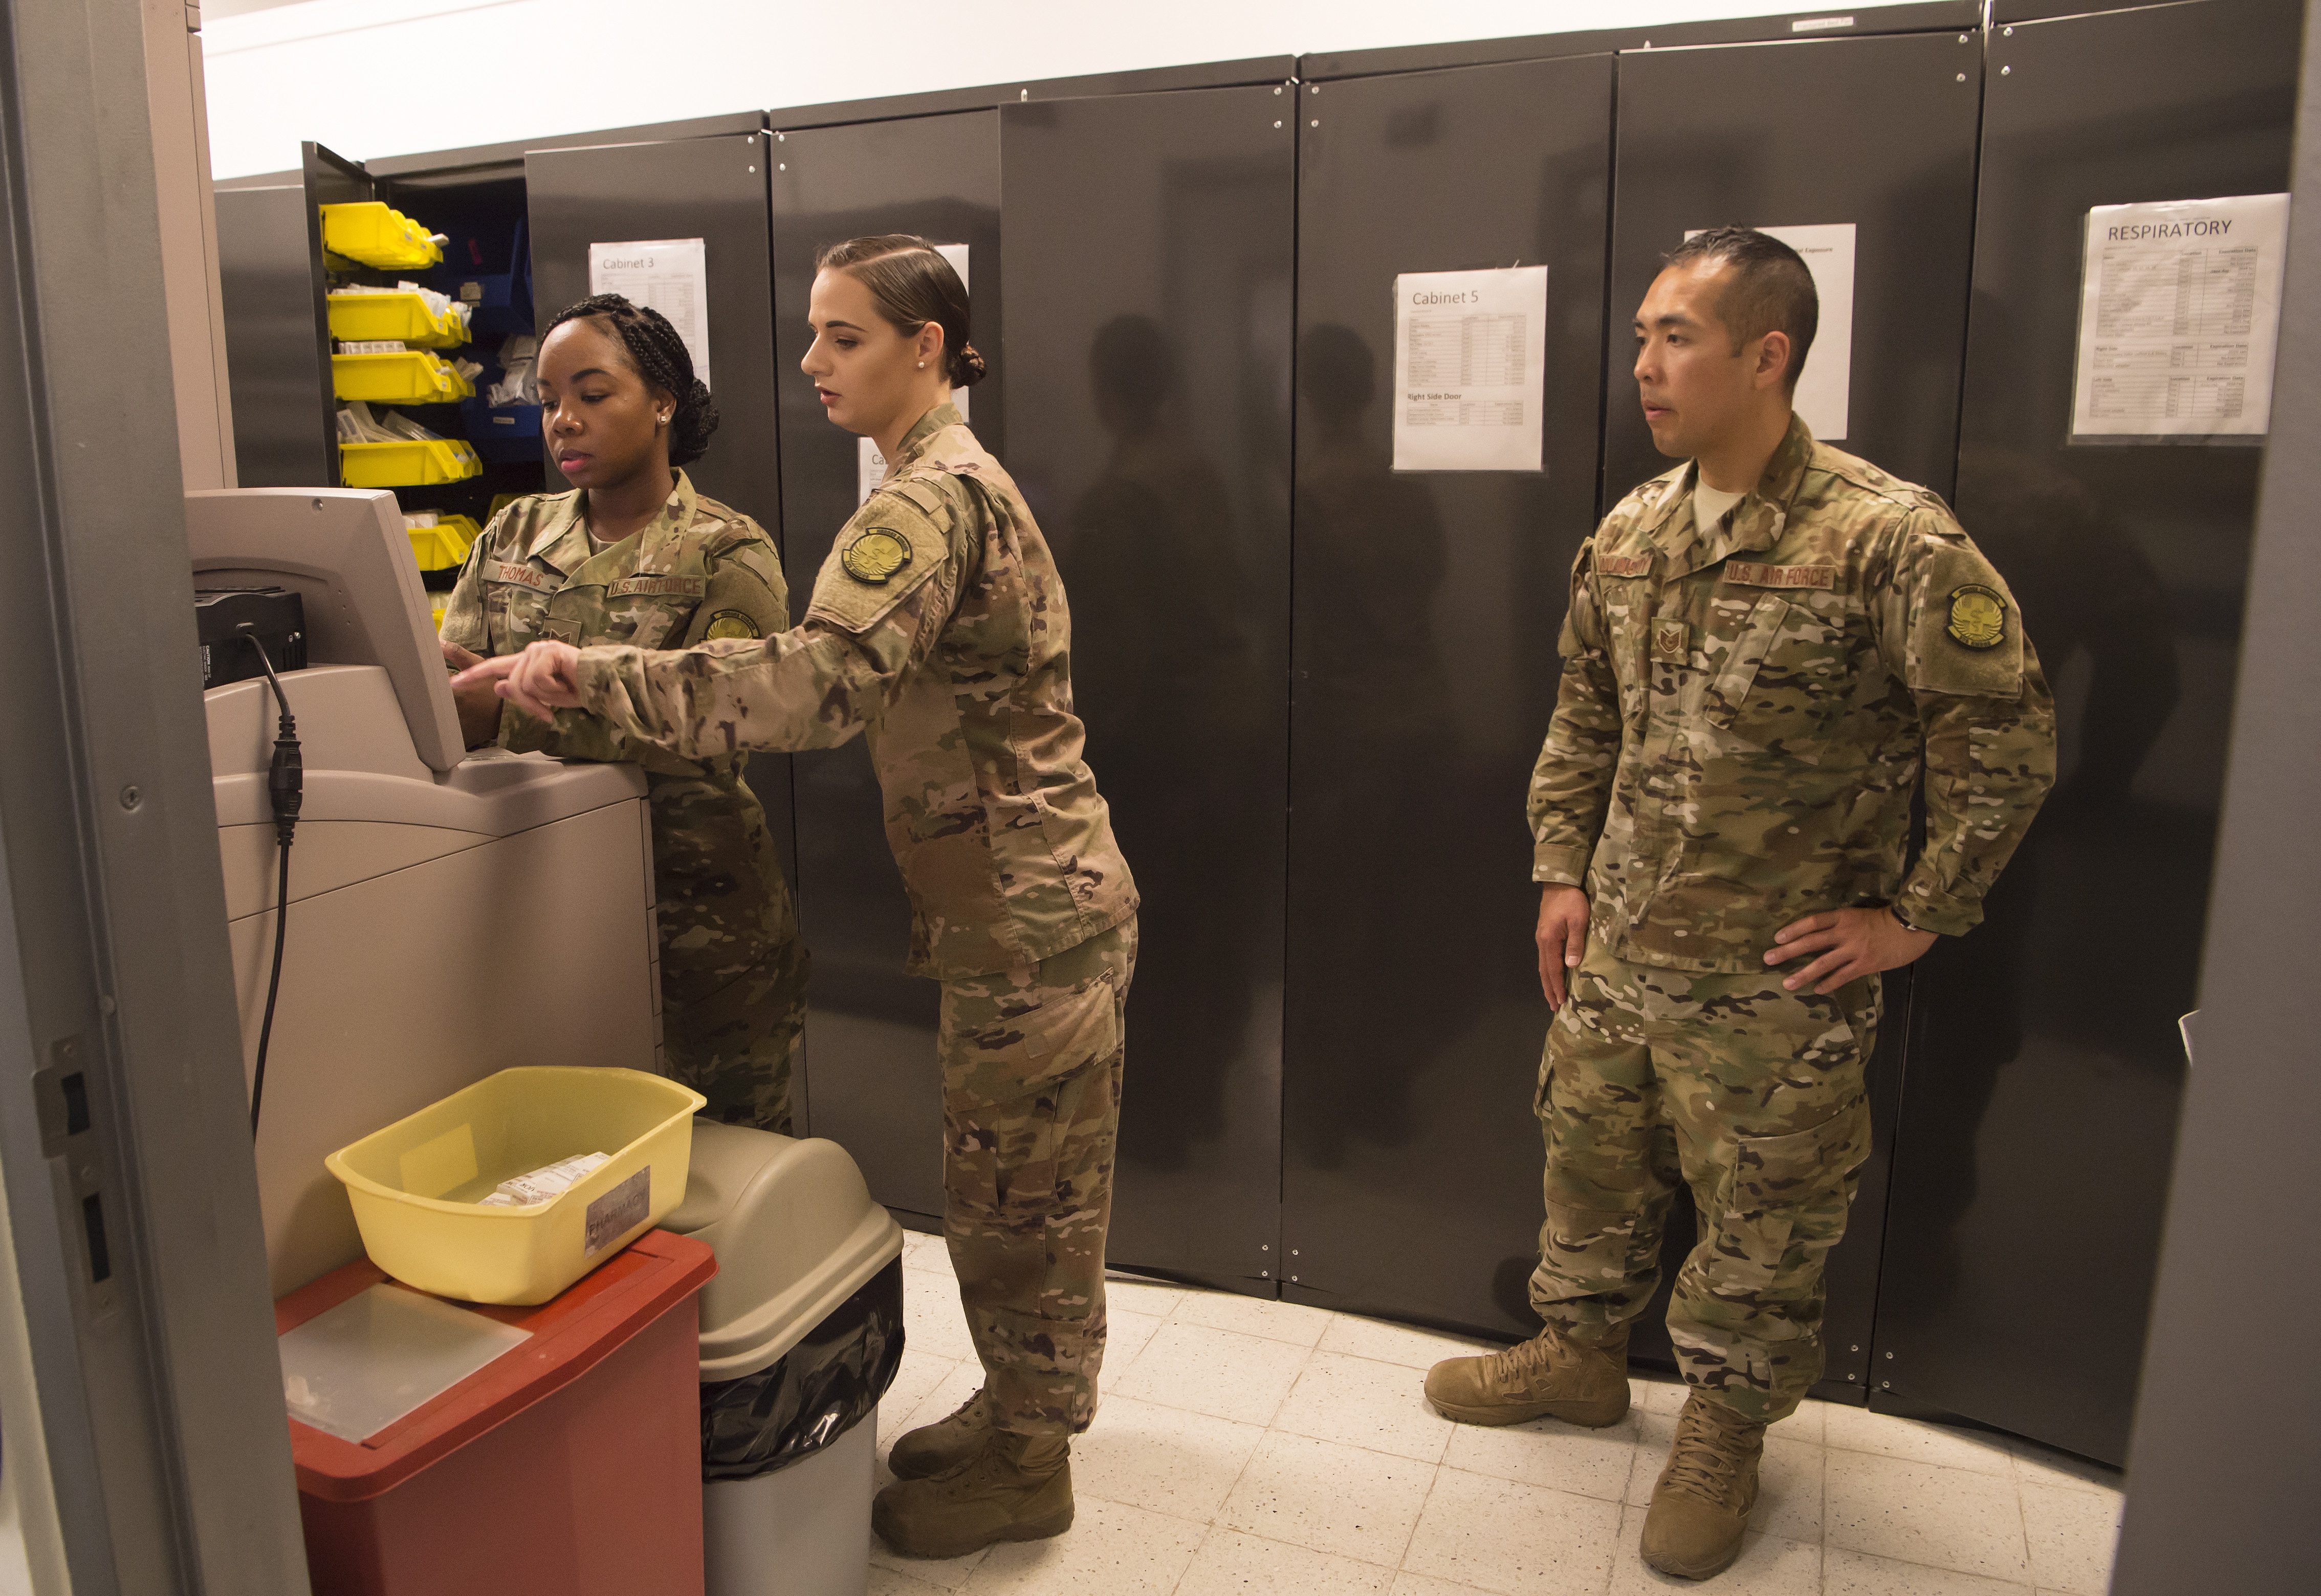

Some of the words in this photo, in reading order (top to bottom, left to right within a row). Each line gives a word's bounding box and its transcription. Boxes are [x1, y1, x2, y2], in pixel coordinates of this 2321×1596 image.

[2108, 219, 2232, 240] RESPIRATORY
[603, 258, 644, 269] Cabinet
[648, 257, 654, 268] 3
[1412, 291, 1466, 305] Cabinet
[1471, 290, 1478, 303] 5
[1408, 393, 1425, 402] Right
[499, 565, 544, 587] THOMAS
[1728, 563, 1754, 582] U.S.
[1758, 565, 1783, 585] AIR
[1786, 568, 1829, 587] FORCE
[610, 580, 632, 596] U.S.
[633, 579, 655, 594] AIR
[655, 578, 701, 595] FORCE
